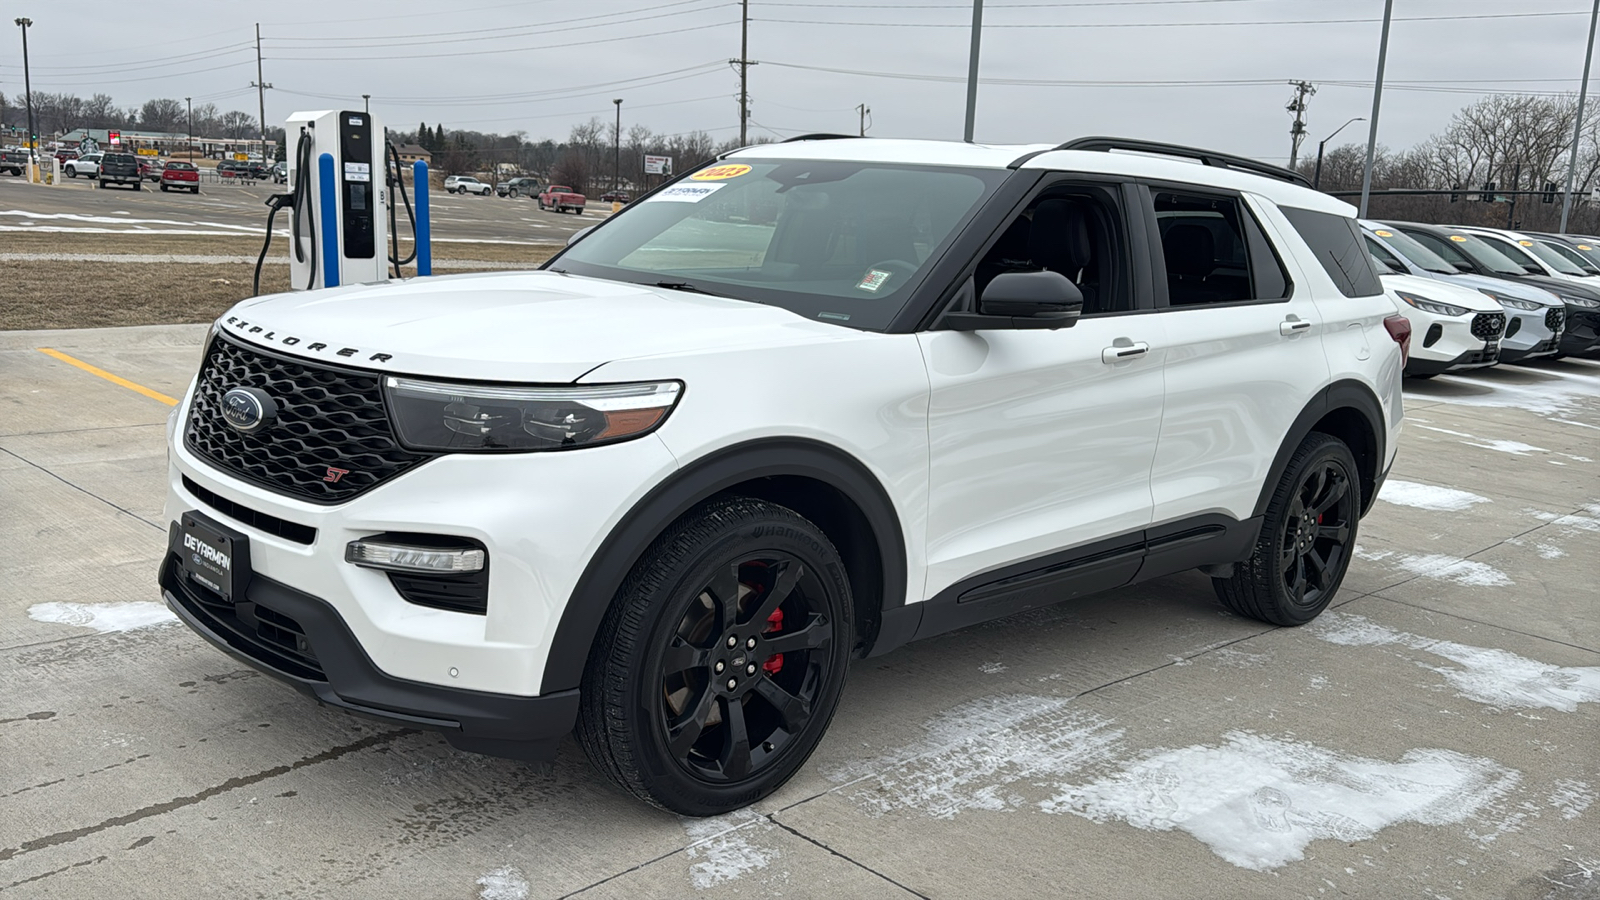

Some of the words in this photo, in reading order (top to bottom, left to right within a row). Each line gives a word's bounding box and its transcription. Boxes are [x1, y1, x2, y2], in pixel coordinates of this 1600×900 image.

[694, 167, 749, 178] 2023
[226, 316, 393, 363] EXPLORER
[323, 467, 350, 483] ST
[184, 532, 231, 571] DEYARMAN
